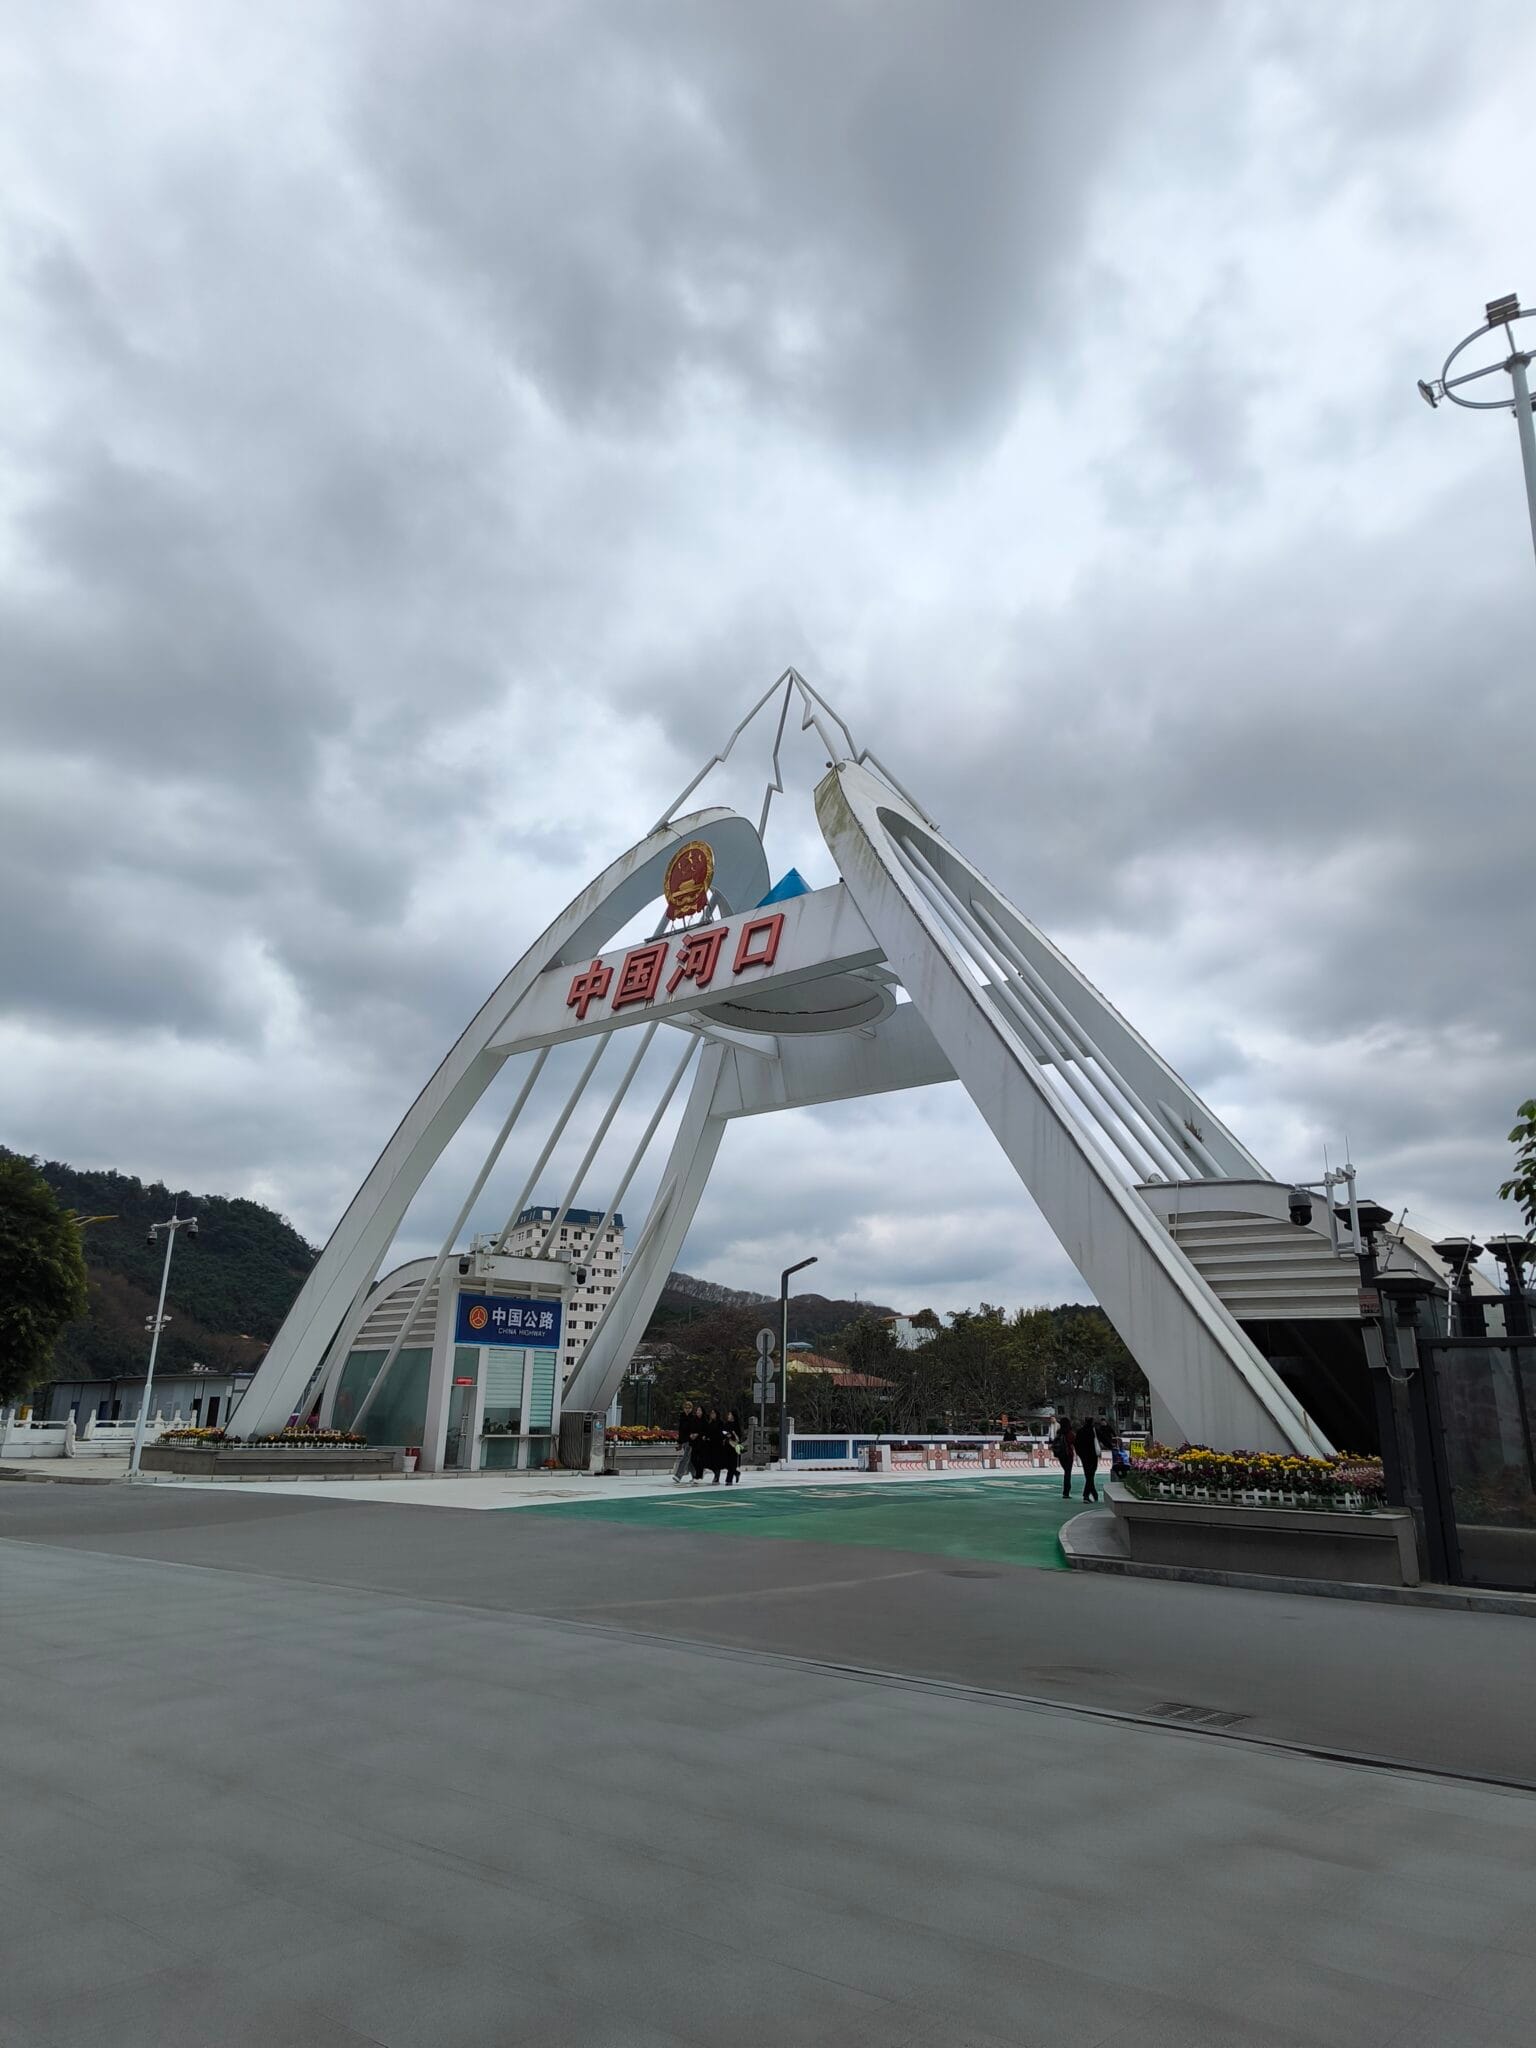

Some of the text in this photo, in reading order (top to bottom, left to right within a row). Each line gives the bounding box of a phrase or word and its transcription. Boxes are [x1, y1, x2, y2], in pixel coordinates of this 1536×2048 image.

[566, 913, 785, 1019] 中国河口
[493, 1307, 553, 1329] 中国公路
[498, 1328, 546, 1337] CHINA HIGHWAY
